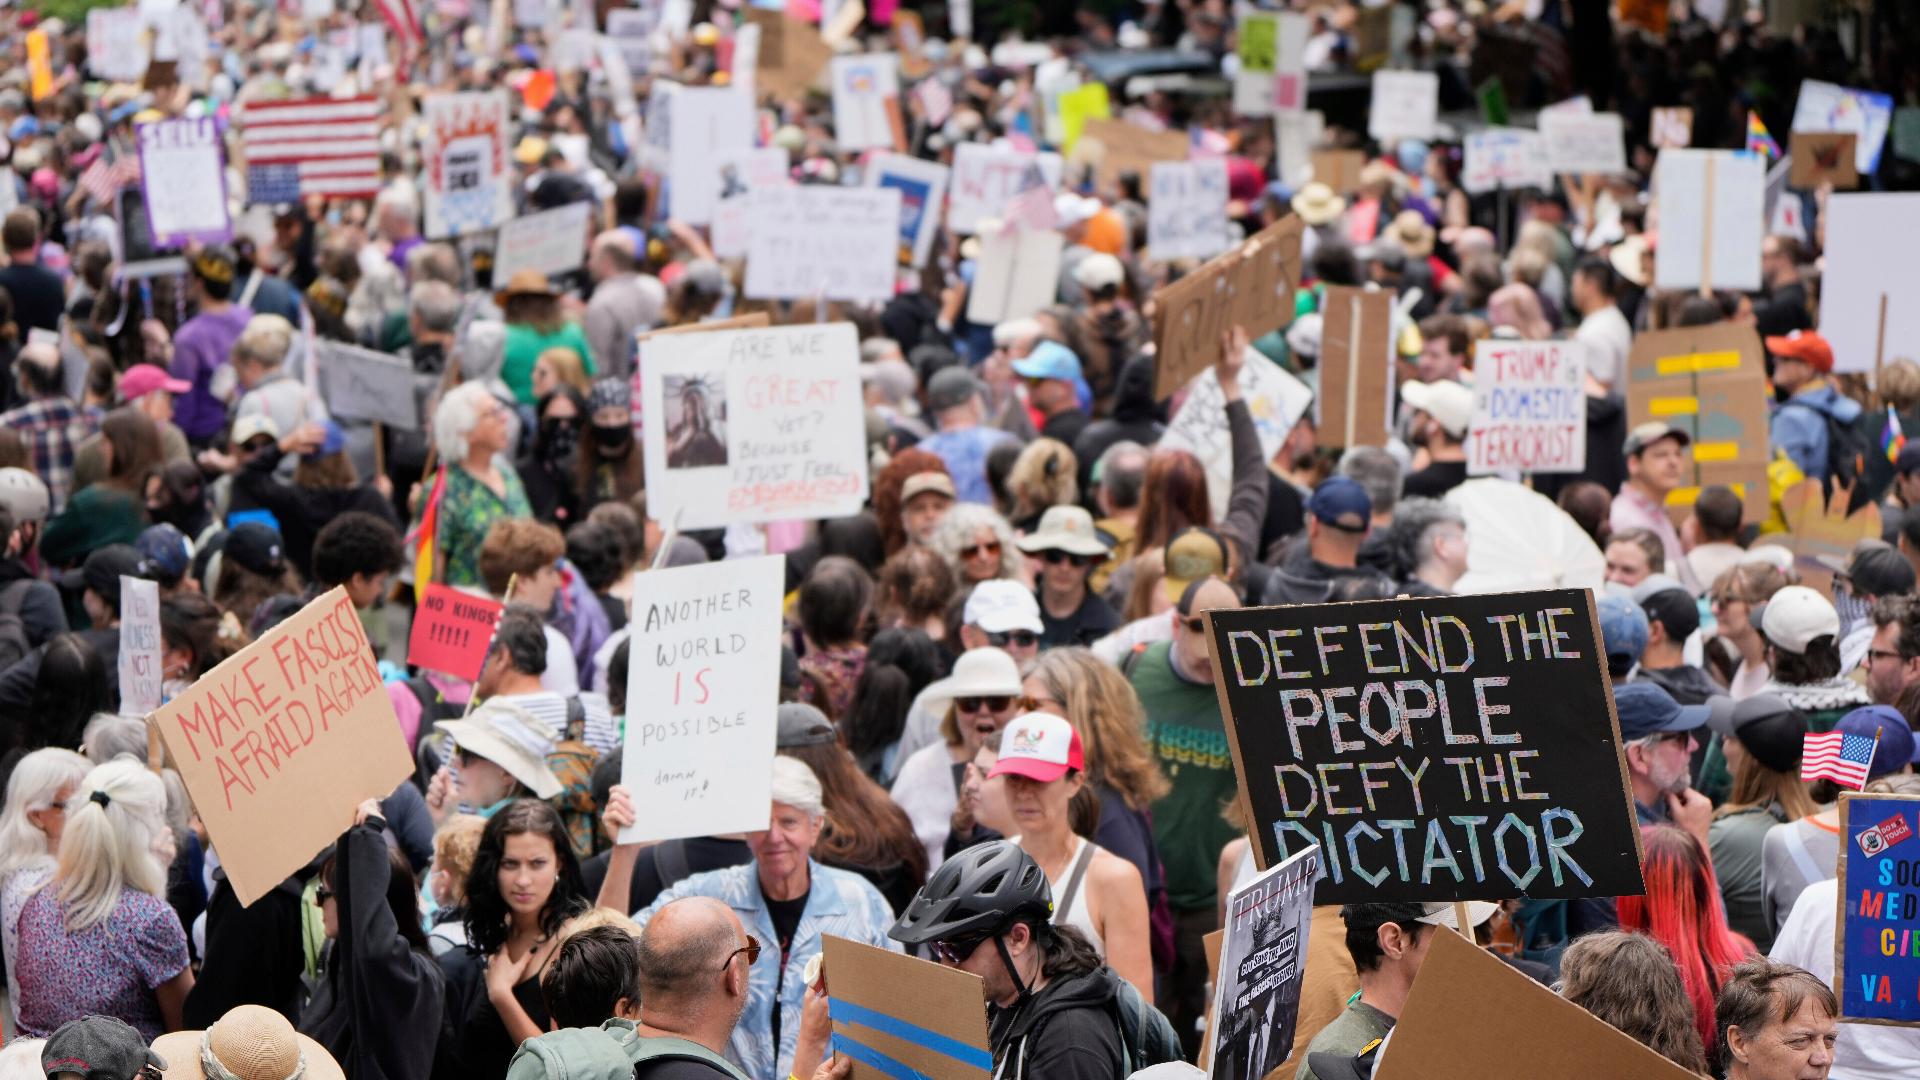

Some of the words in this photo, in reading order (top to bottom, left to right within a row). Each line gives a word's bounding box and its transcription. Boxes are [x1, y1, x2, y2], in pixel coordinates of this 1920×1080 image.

[729, 335, 776, 364] ARE
[787, 333, 825, 356] WE
[1489, 347, 1560, 382] TRUMP
[746, 373, 841, 411] GREAT
[1490, 387, 1580, 420] DOMESTIC
[739, 440, 814, 460] BECAUSE
[1472, 424, 1576, 467] TERRORIST
[746, 463, 793, 484] JUST
[802, 460, 849, 482] FEEL
[425, 596, 444, 611] NO
[453, 602, 496, 625] KINGS
[644, 589, 752, 632] ANOTHER
[656, 633, 746, 667] WORLD
[1228, 611, 1475, 687] DEFEND
[1486, 608, 1581, 663] THE
[176, 656, 281, 761] MAKE
[271, 596, 366, 691] FASCIST
[674, 668, 711, 705] IS
[215, 700, 314, 811] AFRAID
[315, 654, 383, 731] AGAIN
[642, 712, 746, 746] POSSIBLE
[1279, 676, 1522, 760] PEOPLE
[1274, 755, 1430, 818] DEFY
[1443, 749, 1550, 802] THE
[1881, 825, 1890, 834] DO
[1885, 826, 1908, 841] TOUCH
[1273, 806, 1595, 892] DICTATOR
[1234, 855, 1317, 932] TRUMP
[1267, 948, 1279, 963] THE
[1280, 934, 1294, 953] KING
[1238, 992, 1250, 1009] THE
[1273, 964, 1294, 988] REGIME
